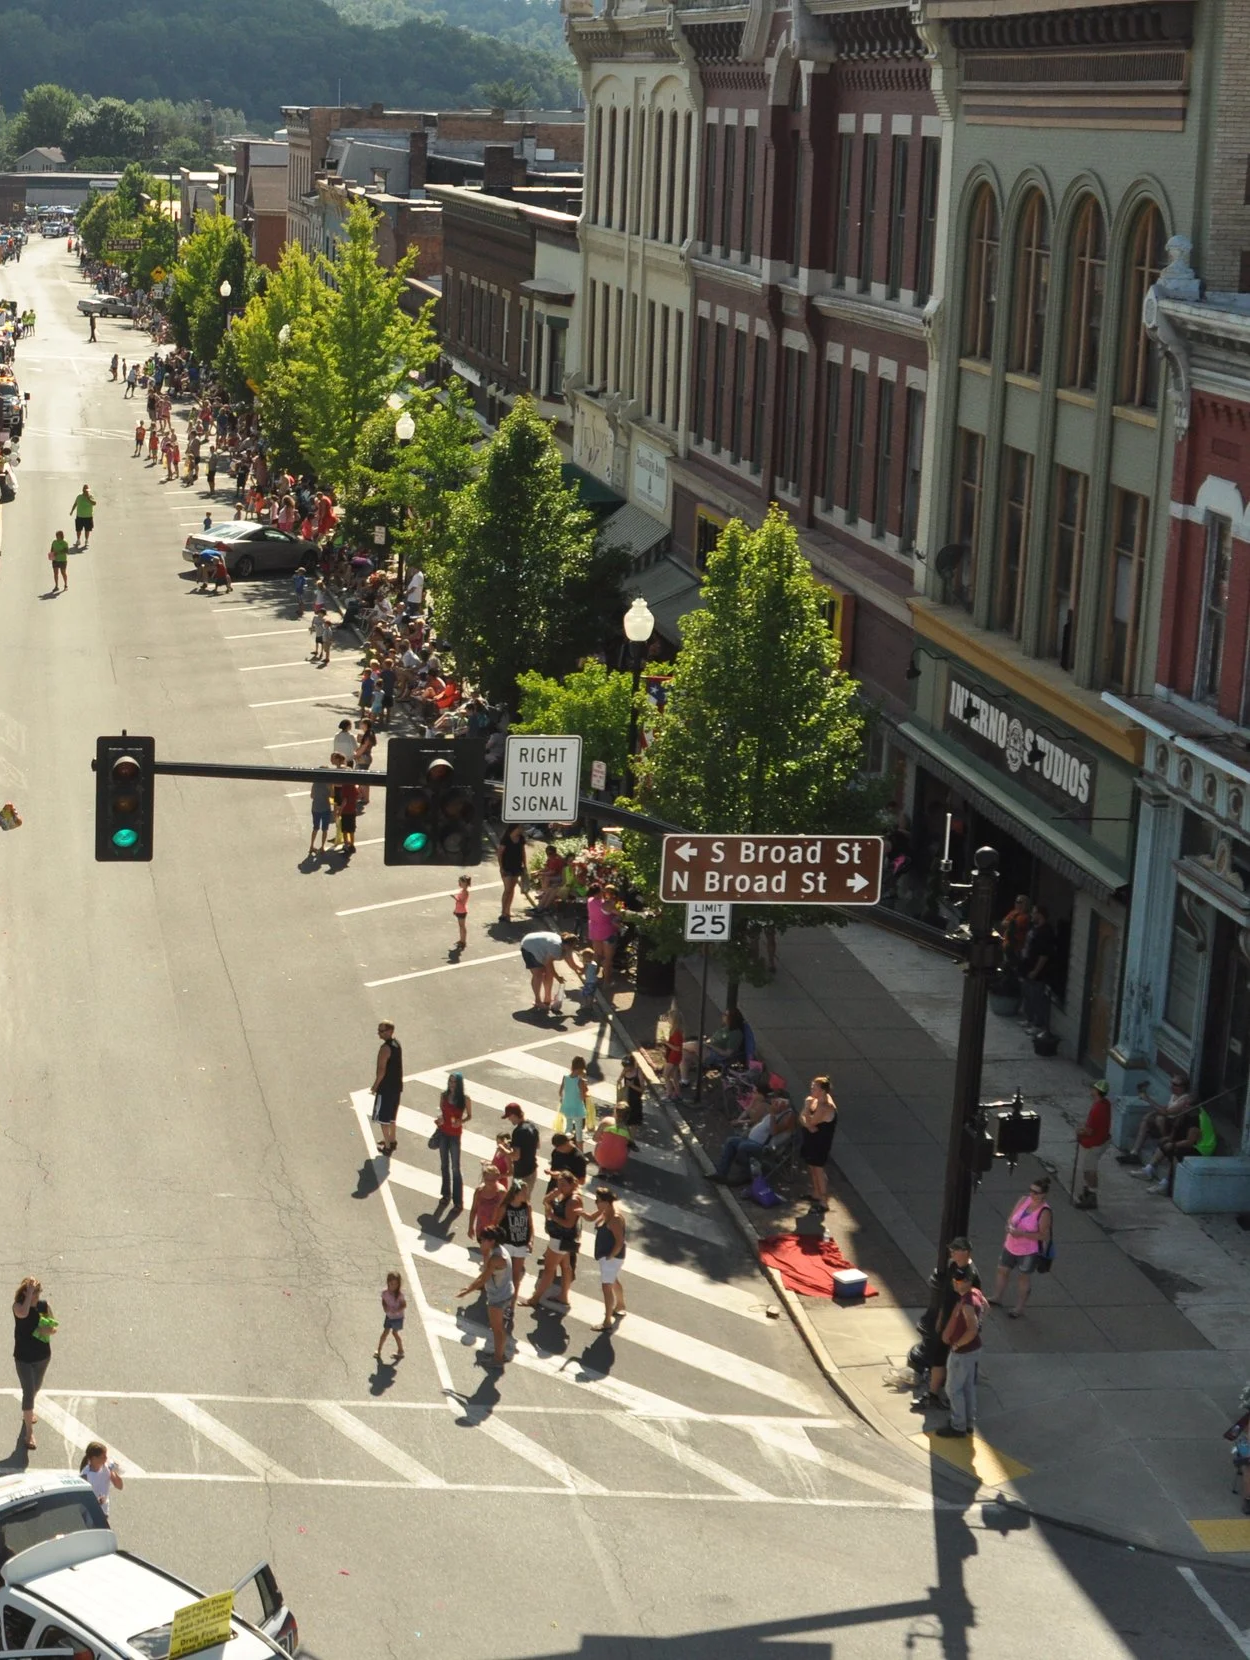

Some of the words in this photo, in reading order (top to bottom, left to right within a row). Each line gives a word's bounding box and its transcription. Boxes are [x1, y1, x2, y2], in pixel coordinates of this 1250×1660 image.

[519, 747, 567, 763] RIGHT
[520, 772, 563, 787] TURN
[512, 796, 568, 811] SIGNAL
[710, 841, 725, 863] S
[739, 840, 821, 864] Broad
[835, 842, 862, 865] St
[671, 870, 689, 892] N
[704, 870, 786, 893] Broad
[800, 871, 827, 894] St
[694, 904, 723, 913] LIMIT
[690, 915, 726, 935] 25
